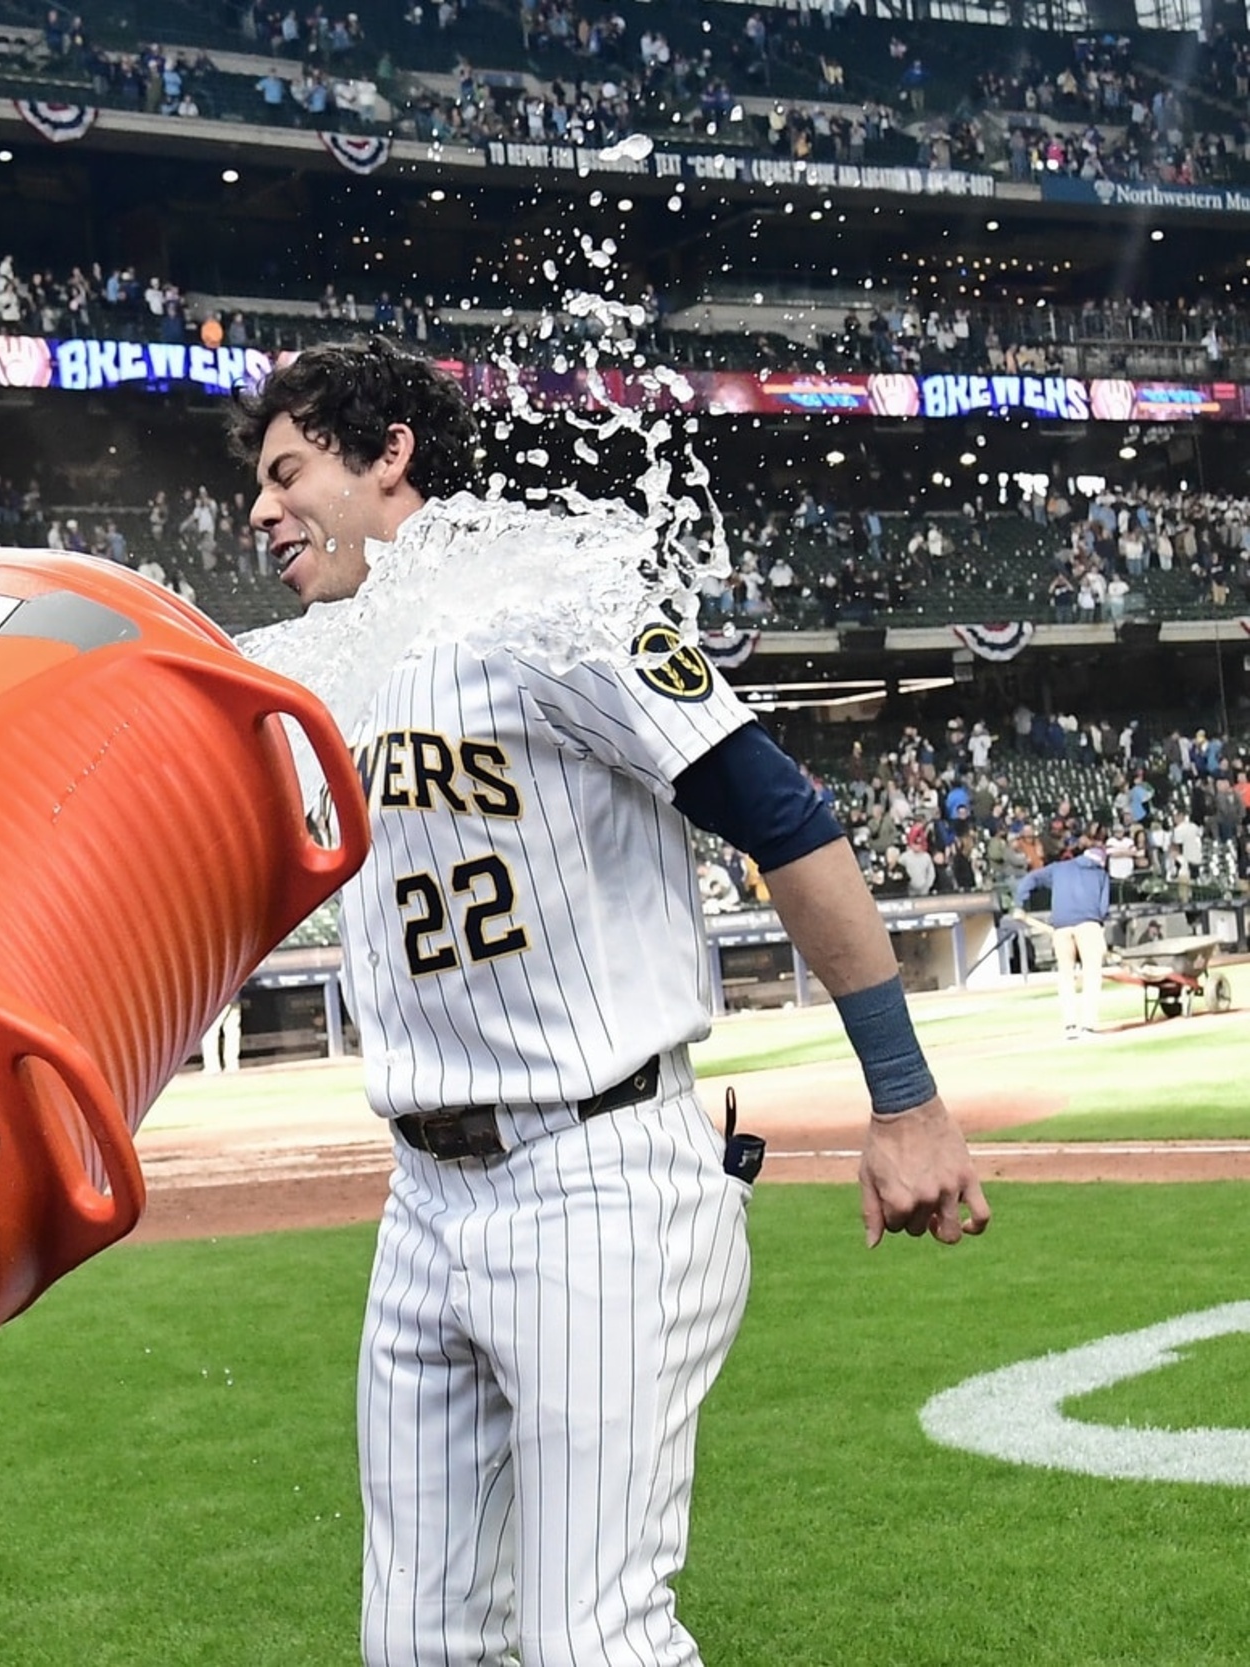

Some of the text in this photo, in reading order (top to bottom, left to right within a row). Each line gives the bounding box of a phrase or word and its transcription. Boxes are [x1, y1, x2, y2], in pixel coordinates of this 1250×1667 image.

[1116, 184, 1222, 209] Northwestern
[921, 374, 1090, 421] BREWERS
[394, 853, 532, 979] 22
